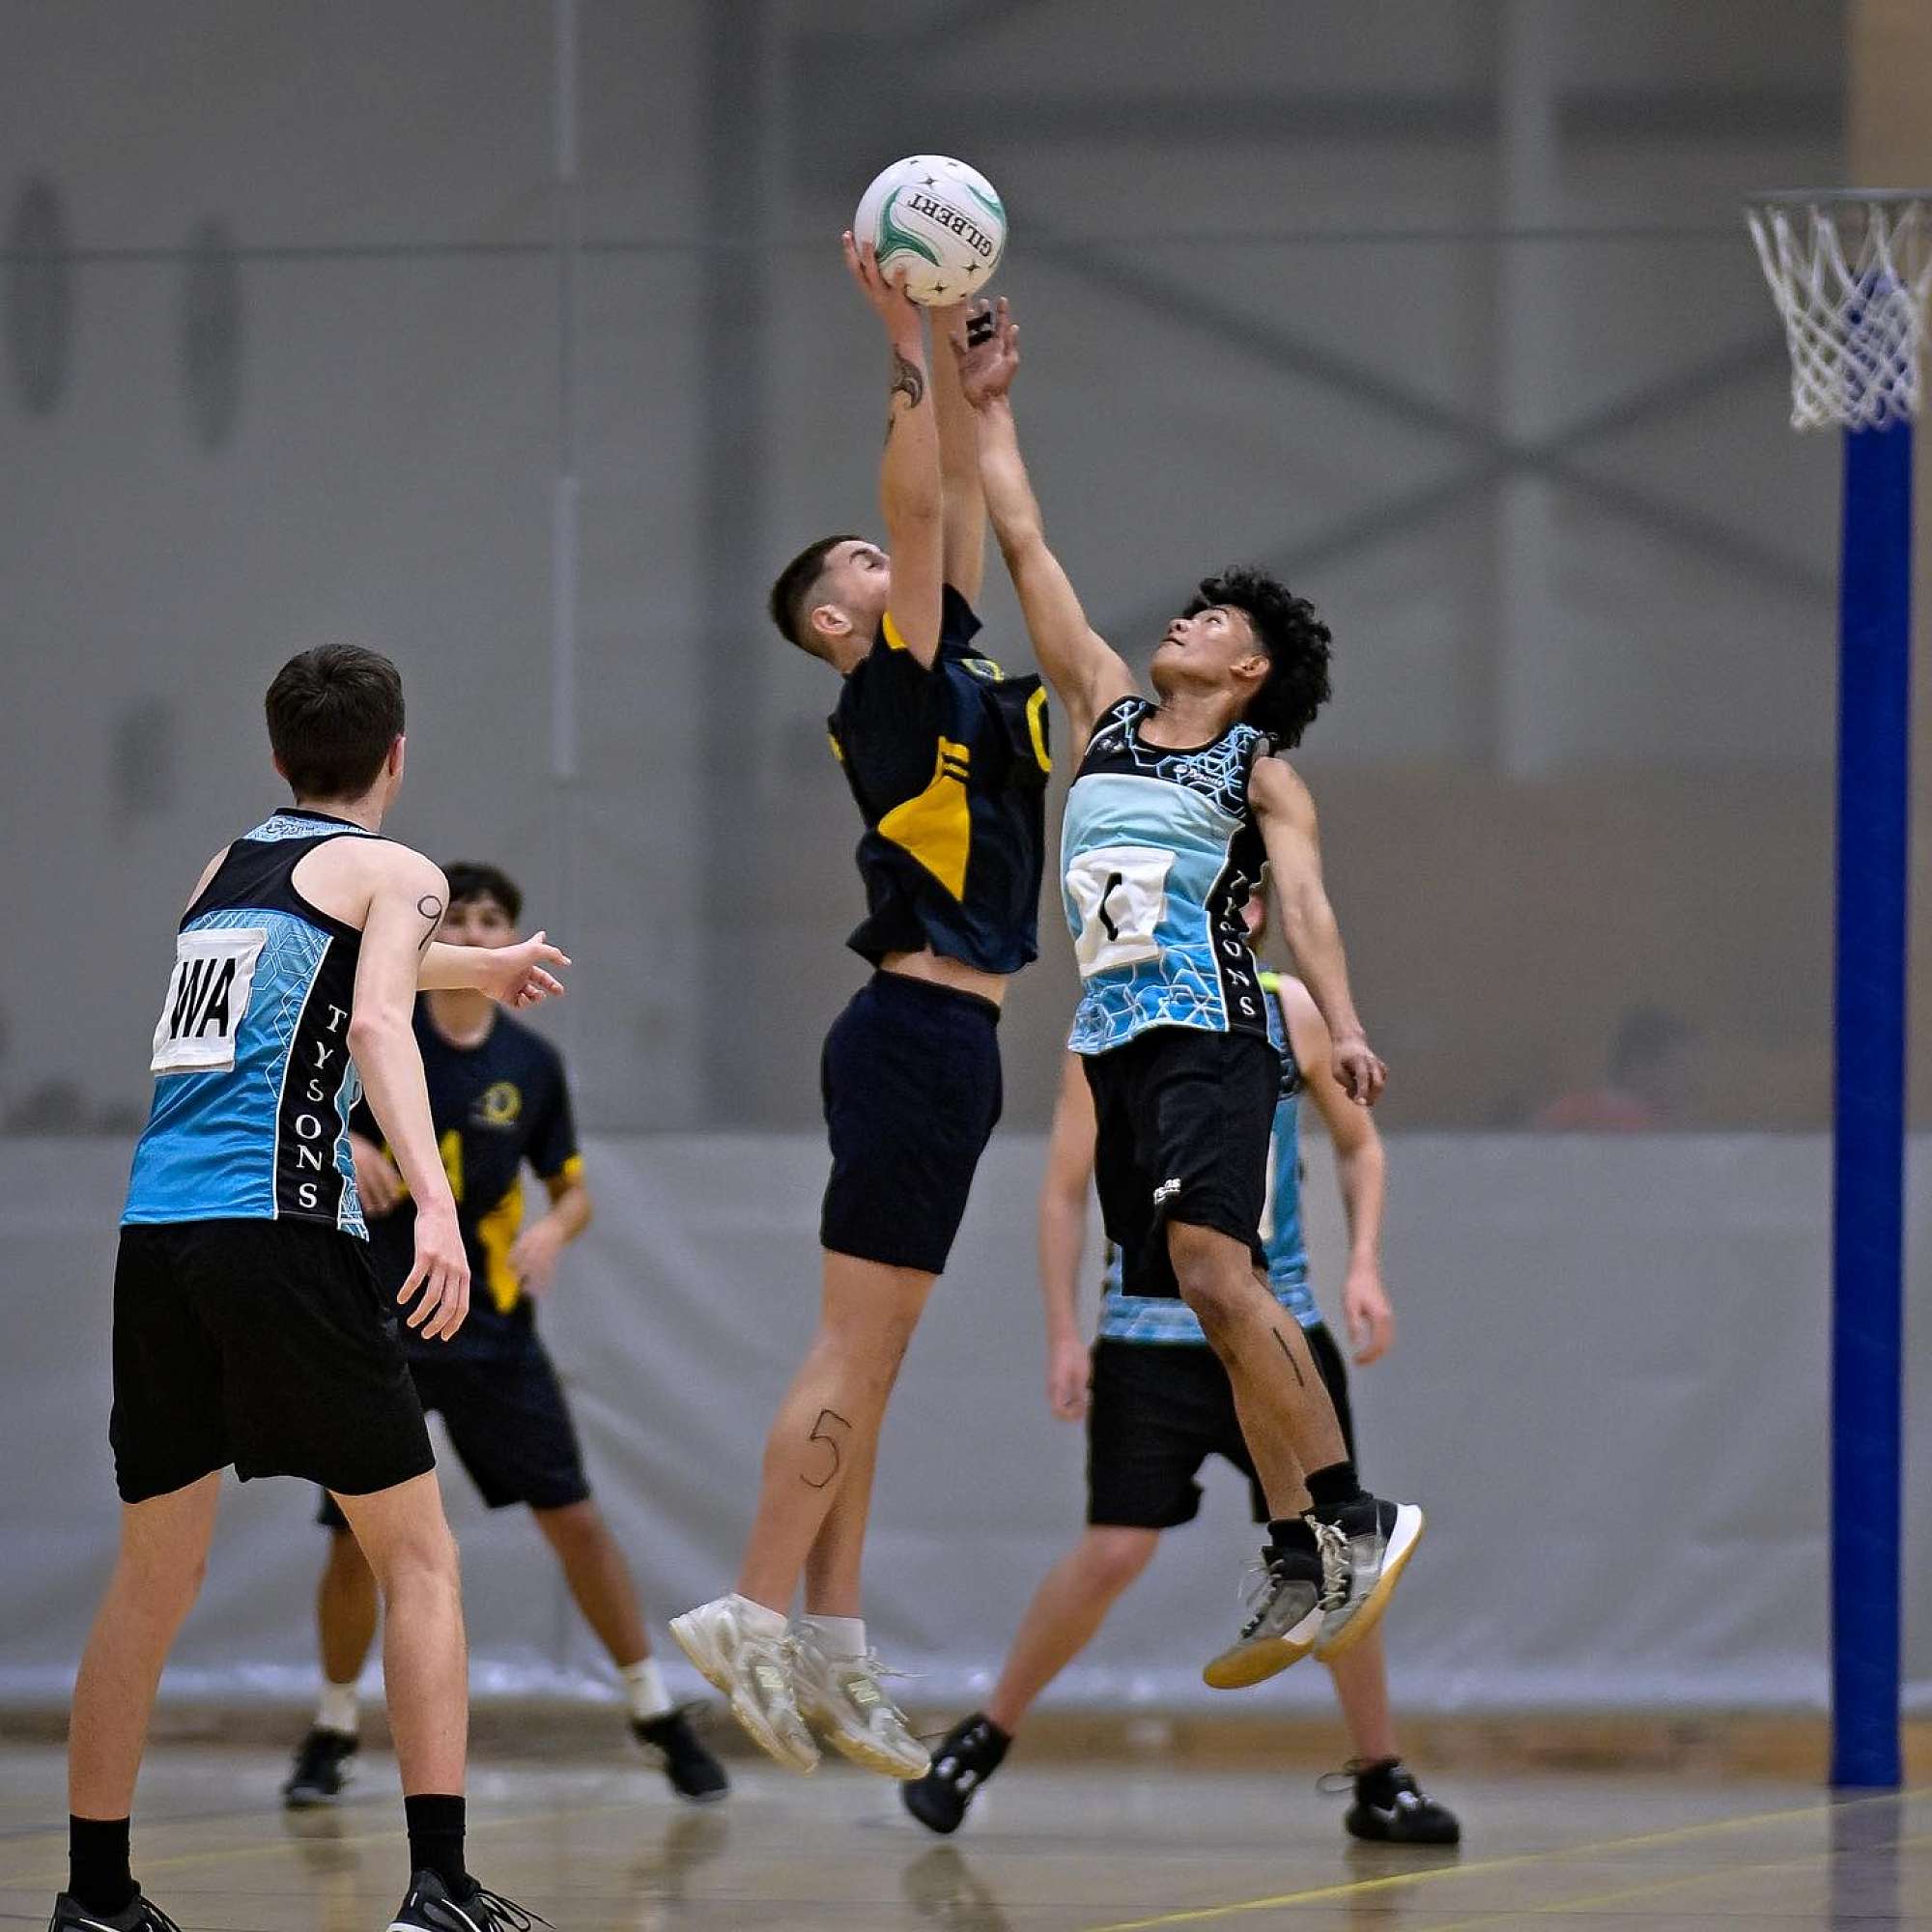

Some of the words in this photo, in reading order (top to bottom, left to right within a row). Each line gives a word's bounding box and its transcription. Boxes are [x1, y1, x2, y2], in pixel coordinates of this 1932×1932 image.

[908, 192, 992, 257] GILBERT
[169, 957, 236, 1040] WA
[296, 1004, 348, 1208] TYSONS
[800, 1407, 853, 1489] 5
